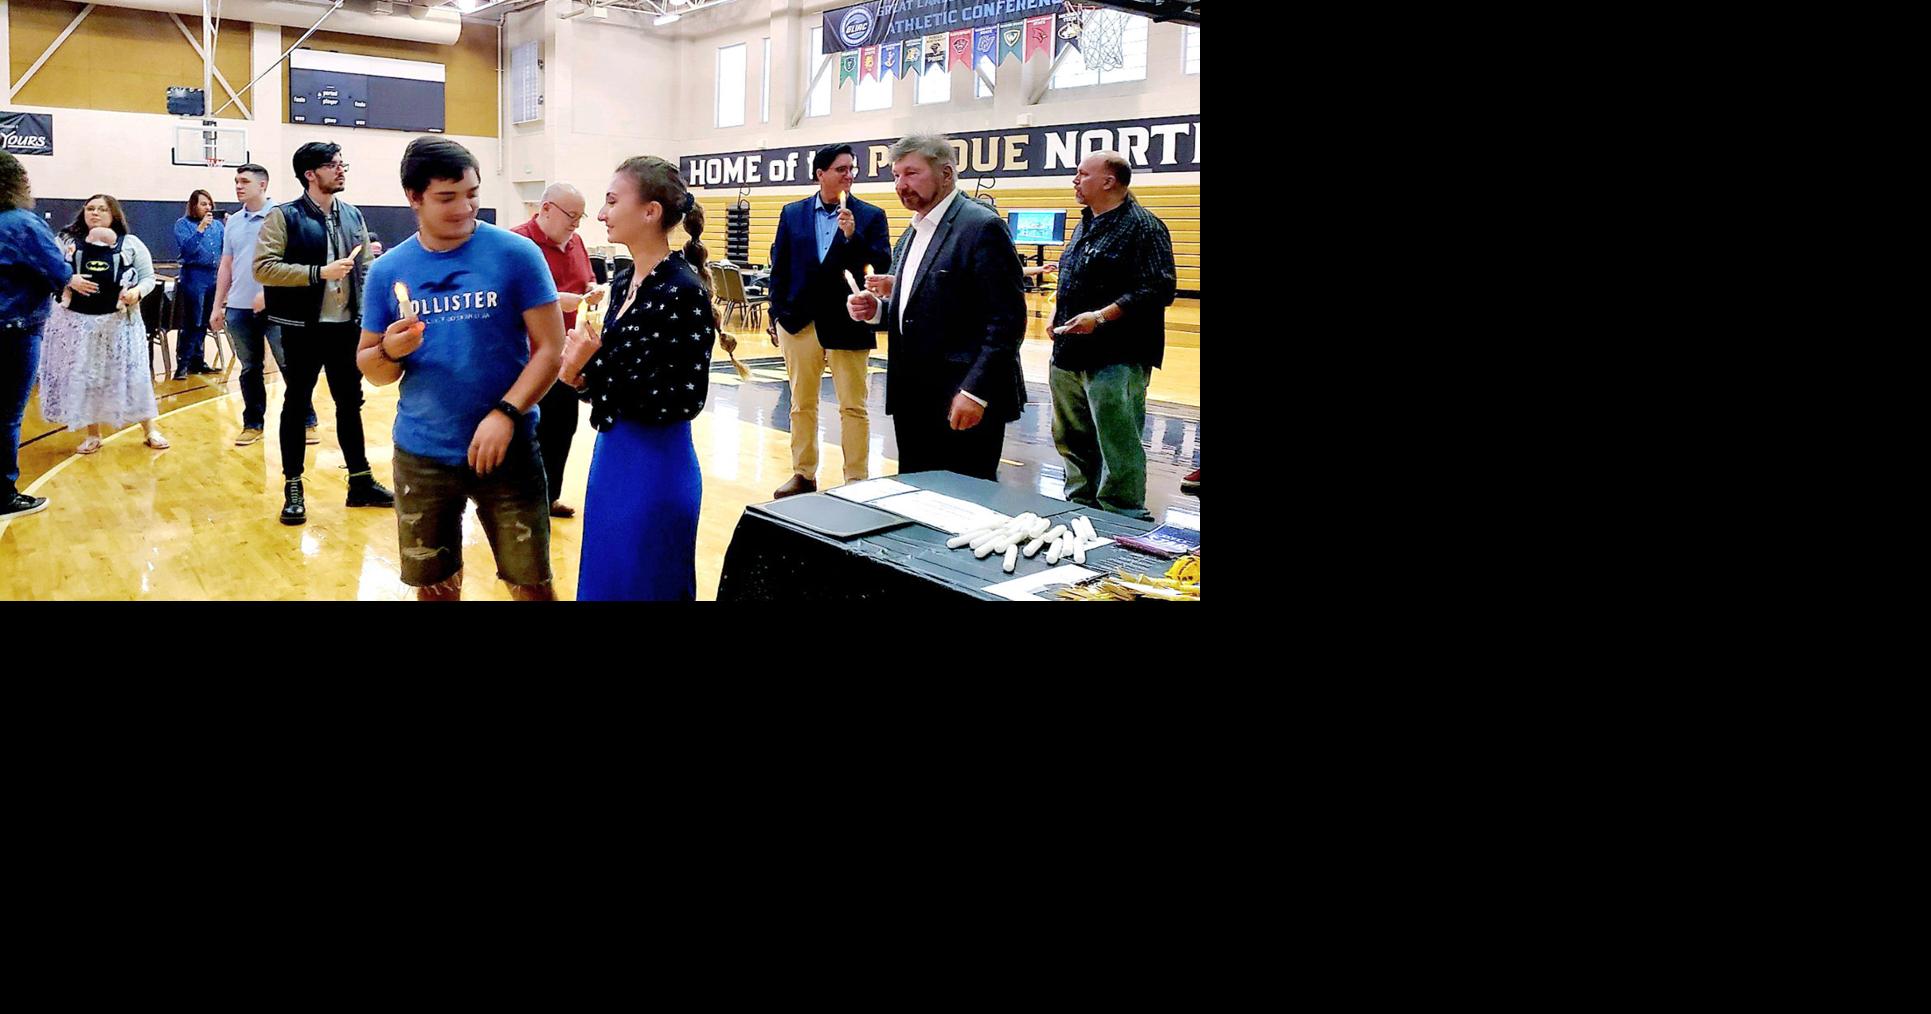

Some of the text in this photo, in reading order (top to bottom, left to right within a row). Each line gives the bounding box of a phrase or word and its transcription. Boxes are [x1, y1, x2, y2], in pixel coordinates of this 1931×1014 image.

[888, 10, 958, 34] ATHLETIC
[962, 0, 1061, 21] CONFEREN
[689, 154, 763, 186] HOME
[768, 152, 799, 182] of
[868, 134, 1029, 177] PDUE
[1044, 122, 1200, 169] NORT
[399, 291, 498, 319] OLLISTER
